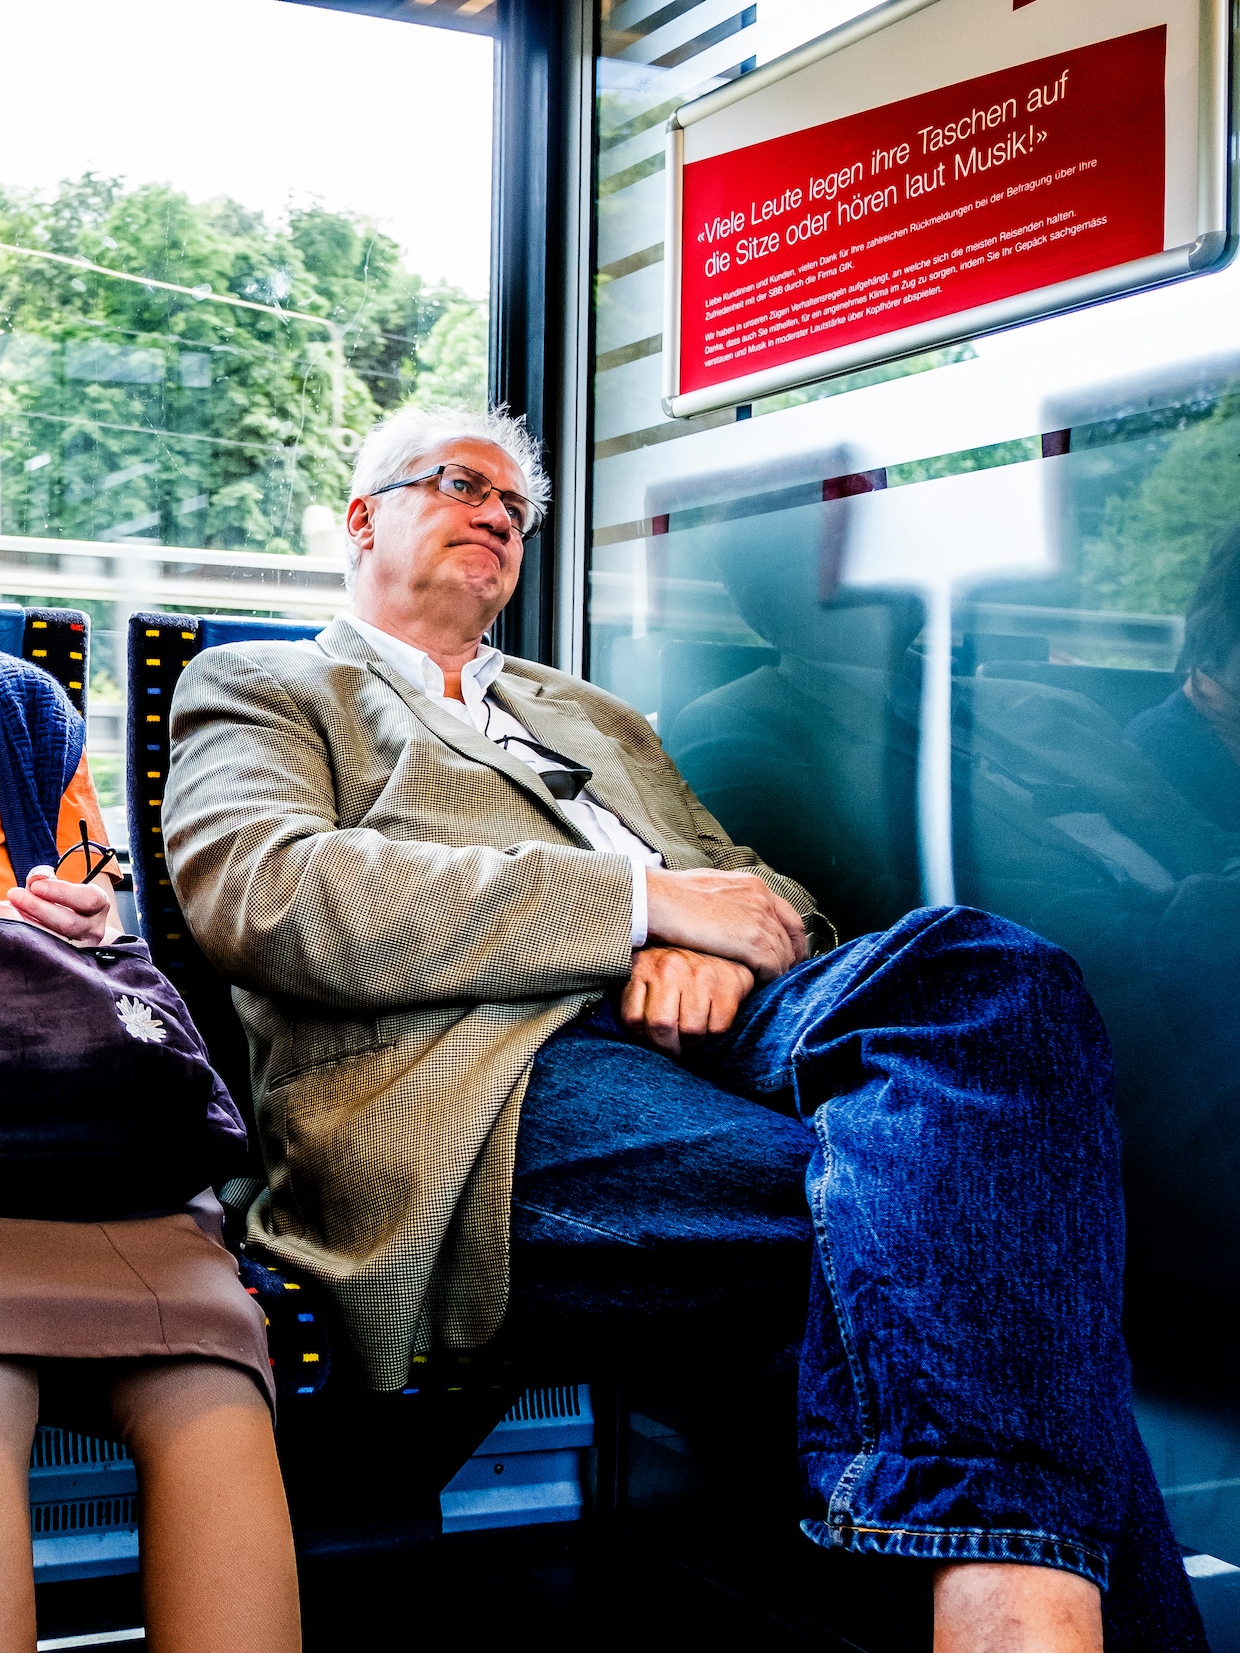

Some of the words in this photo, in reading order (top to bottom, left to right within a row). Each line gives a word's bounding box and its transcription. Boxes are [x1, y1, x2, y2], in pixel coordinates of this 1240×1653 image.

[697, 211, 745, 243] «Viele
[751, 187, 802, 225] Leute
[809, 162, 863, 200] legen
[871, 142, 909, 175] ihre
[917, 98, 1017, 154] Taschen
[1026, 69, 1069, 112] auf
[705, 251, 730, 277] die
[736, 231, 780, 265] Sitze
[785, 210, 831, 245] oder
[838, 185, 897, 226] hören
[905, 162, 946, 199] laut
[954, 125, 1048, 180] Musik!»
[704, 332, 715, 341] Wir
[716, 325, 735, 338] haben
[736, 323, 743, 331] in
[743, 314, 768, 329] unseren
[769, 307, 790, 321] Zügen
[791, 287, 846, 313] Verhaltensregeln
[848, 272, 890, 293] aufgehängt,
[892, 269, 902, 278] an
[904, 258, 931, 274] welche
[932, 252, 949, 264] sich
[951, 247, 963, 259] die
[965, 236, 997, 253] meisten
[999, 219, 1044, 242] Reisenden
[1046, 209, 1076, 225] halten.
[704, 342, 724, 355] Danke,
[726, 336, 741, 348] dass
[741, 331, 757, 343] auch
[758, 327, 768, 337] Sie
[769, 317, 799, 333] mithelfen,
[801, 313, 810, 322] für
[811, 310, 822, 319] ein
[823, 295, 867, 315] angenehmes
[868, 288, 889, 300] Klima
[890, 283, 899, 293] im
[901, 278, 916, 290] Zug
[918, 275, 927, 285] zu
[929, 264, 958, 282] sorgen,
[960, 256, 984, 271] indem
[987, 250, 1000, 262] Sie
[1002, 246, 1013, 257] Ihr
[1015, 234, 1048, 253] Gepäck
[1049, 215, 1107, 241] sachgemäss
[704, 301, 745, 321] Zufriedenheit
[745, 296, 755, 306] mit
[756, 292, 767, 303] der
[768, 286, 784, 298] SBB
[784, 279, 804, 292] durch
[805, 275, 817, 285] die
[817, 267, 837, 280] Firma
[705, 295, 722, 308] Liebe
[723, 284, 755, 301] Kundinnen
[756, 277, 768, 289] und
[769, 268, 796, 284] Kunden,
[798, 259, 818, 273] vielen
[819, 252, 838, 266] Dank
[839, 248, 849, 259] für
[850, 243, 864, 254] Ihre
[866, 227, 908, 249] zahlreichen
[909, 203, 973, 233] Rückmeldungen
[975, 196, 988, 209] bei
[990, 190, 1004, 203] der
[1006, 173, 1053, 198] Befragung
[1054, 165, 1076, 180] über
[1078, 158, 1097, 172] Ihre
[704, 352, 734, 368] verstauen
[734, 346, 747, 358] und
[747, 341, 767, 354] Musik
[767, 337, 774, 347] in
[775, 328, 809, 345] moderater
[810, 315, 846, 334] Lautstärke
[847, 310, 864, 322] über
[865, 298, 901, 316] Kopfhörer
[902, 285, 943, 304] abspielen.
